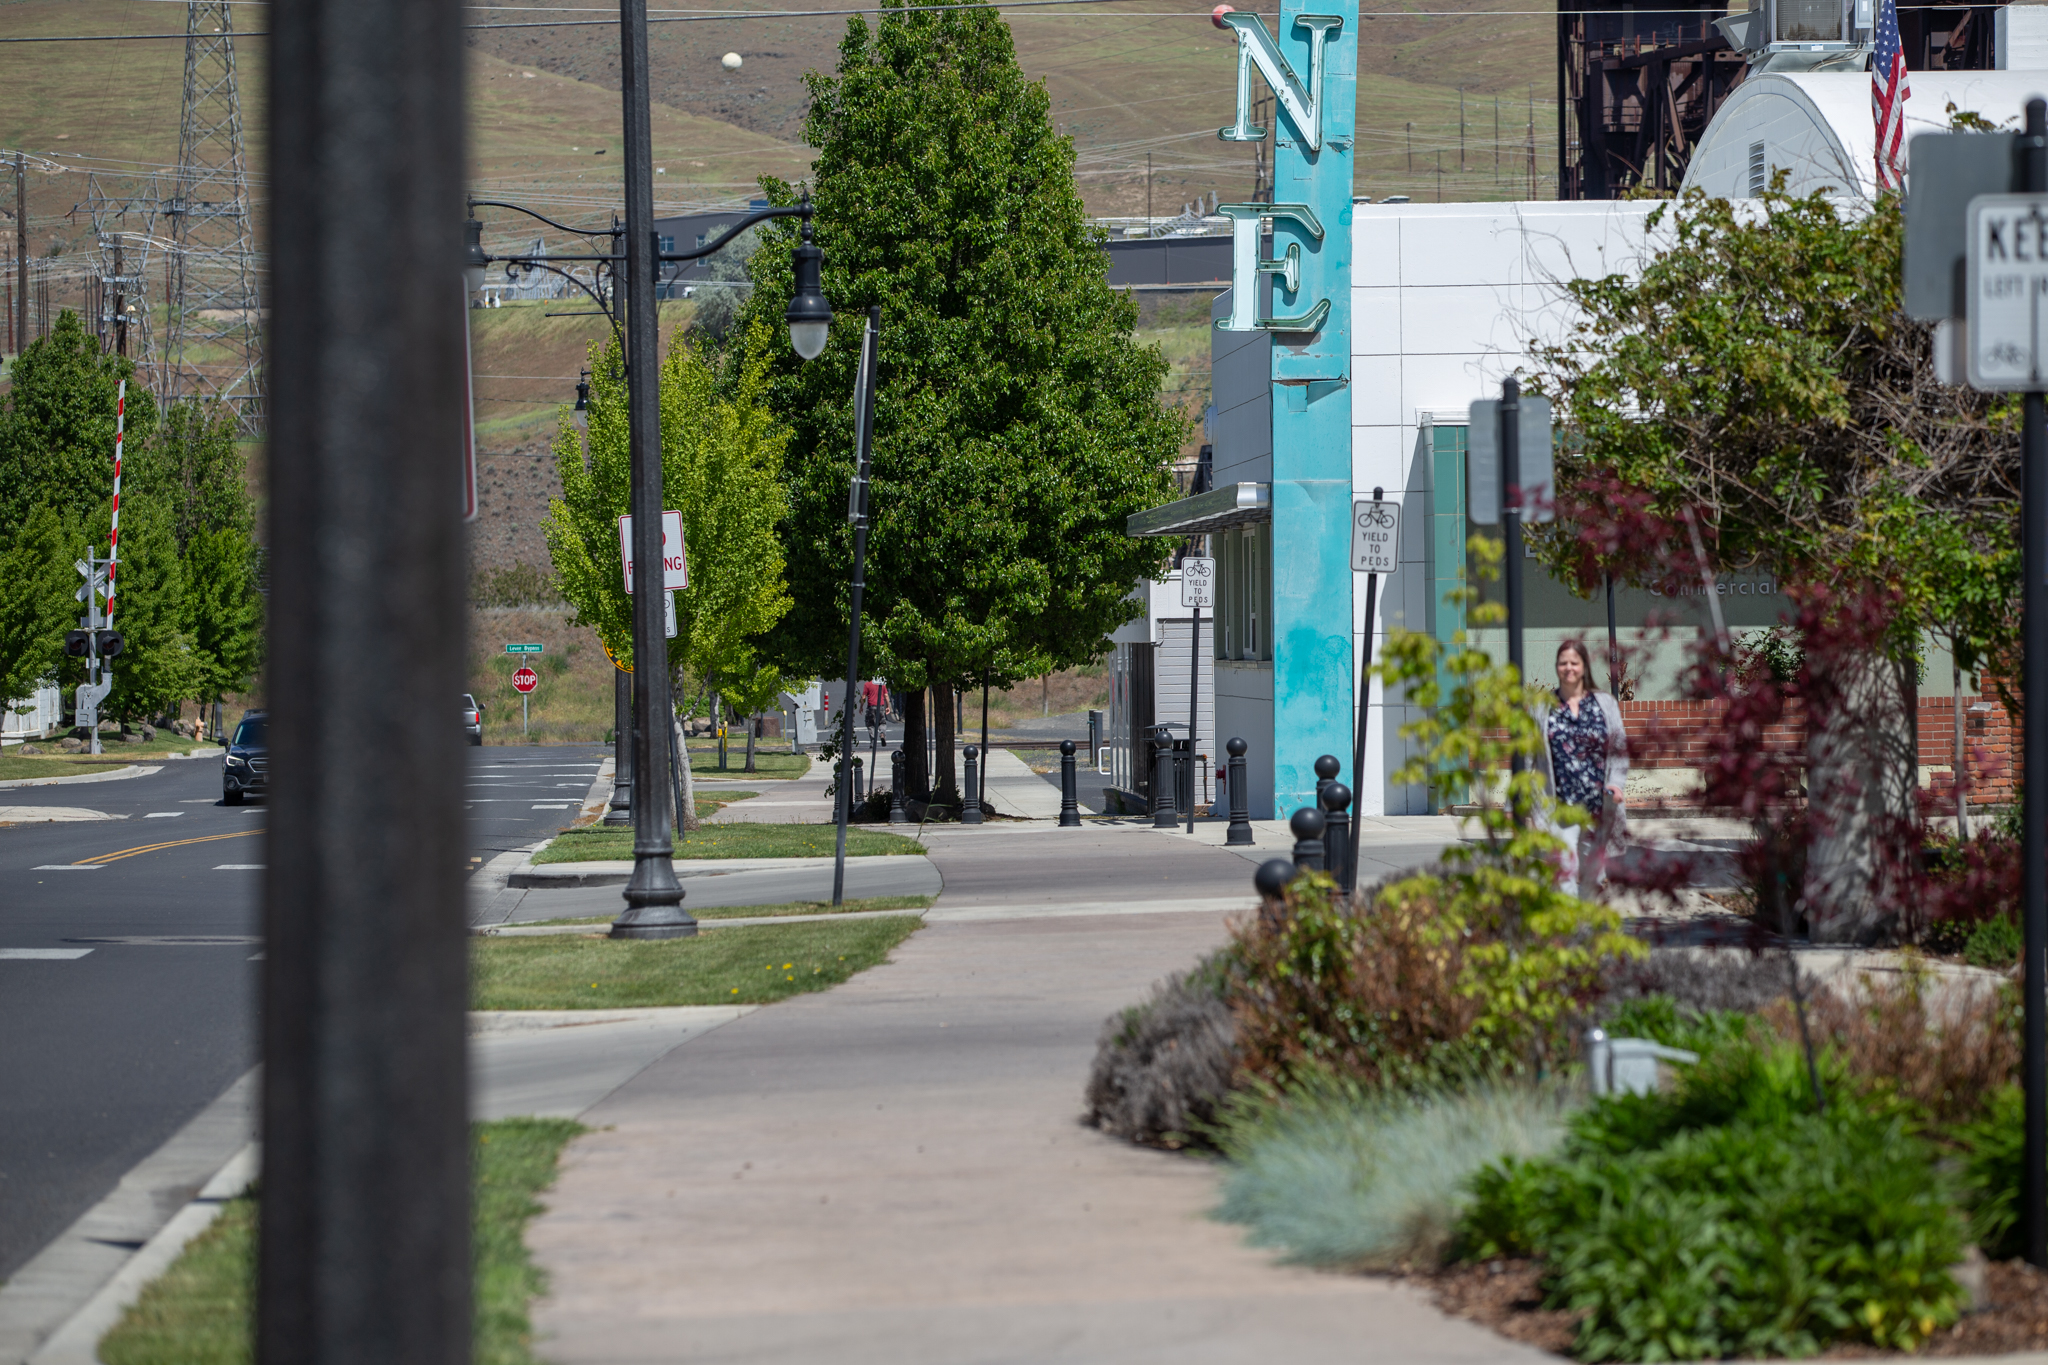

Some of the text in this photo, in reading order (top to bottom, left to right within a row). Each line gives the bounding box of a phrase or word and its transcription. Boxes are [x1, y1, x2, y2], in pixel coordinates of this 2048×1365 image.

[1362, 531, 1388, 542] YIELD
[1369, 544, 1381, 554] TO
[1361, 556, 1389, 567] PEDS
[1188, 579, 1207, 587] YIELD
[514, 675, 536, 686] STOP
